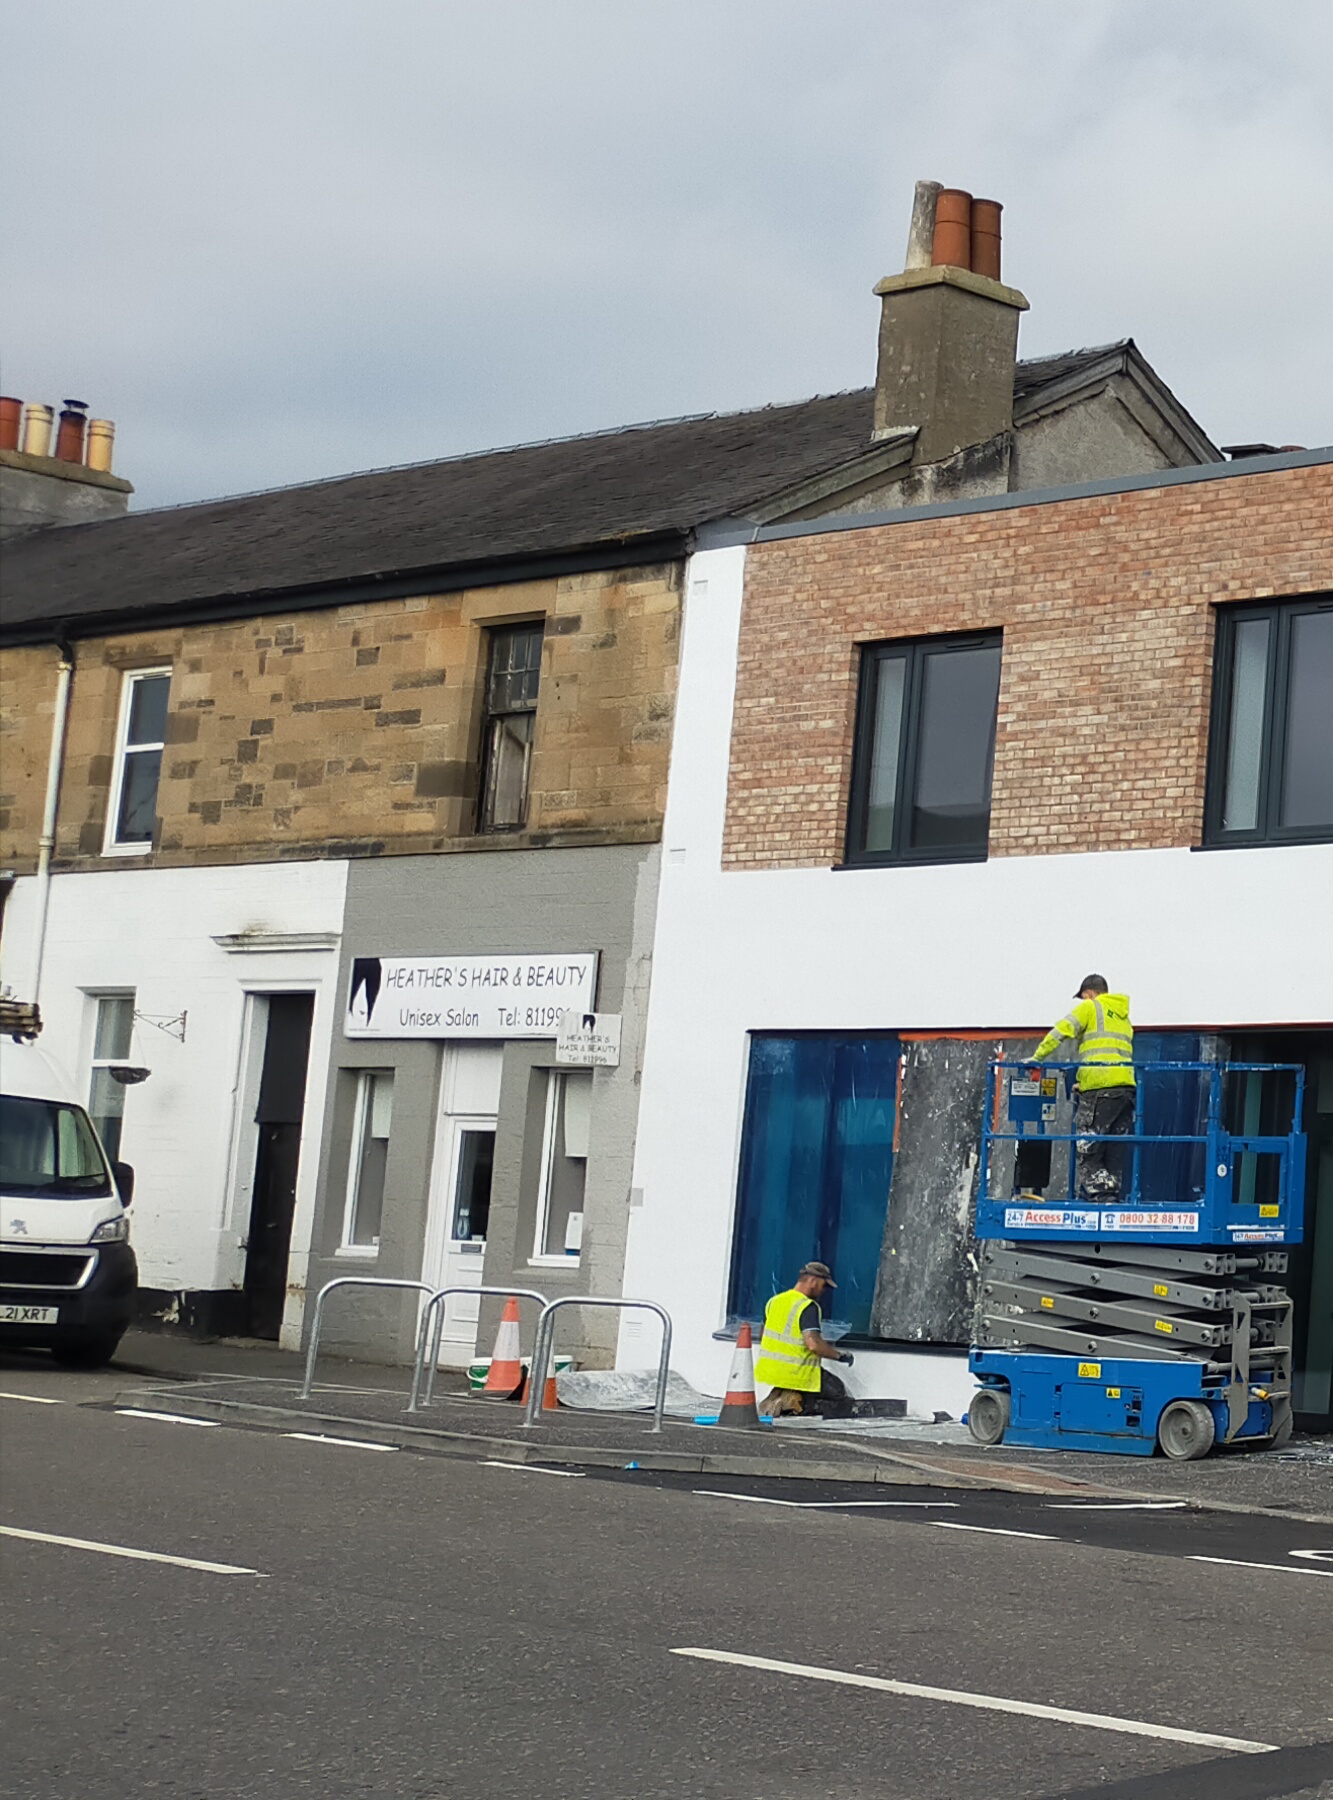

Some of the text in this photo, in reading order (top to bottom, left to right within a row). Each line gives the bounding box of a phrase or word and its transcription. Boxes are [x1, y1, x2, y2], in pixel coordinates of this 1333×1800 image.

[386, 964, 587, 989] HEATHER'S HAIR & BEAUTY
[399, 1008, 442, 1027] Unisex
[445, 1008, 480, 1027] Salon
[497, 1007, 522, 1027] Tel:
[566, 1034, 610, 1044] HEATHER'S
[558, 1044, 579, 1052] HAIR
[587, 1044, 617, 1054] BEAUTY
[1119, 1213, 1144, 1224] 0800
[1177, 1214, 1196, 1225] 178
[20, 1307, 50, 1321] XRT
